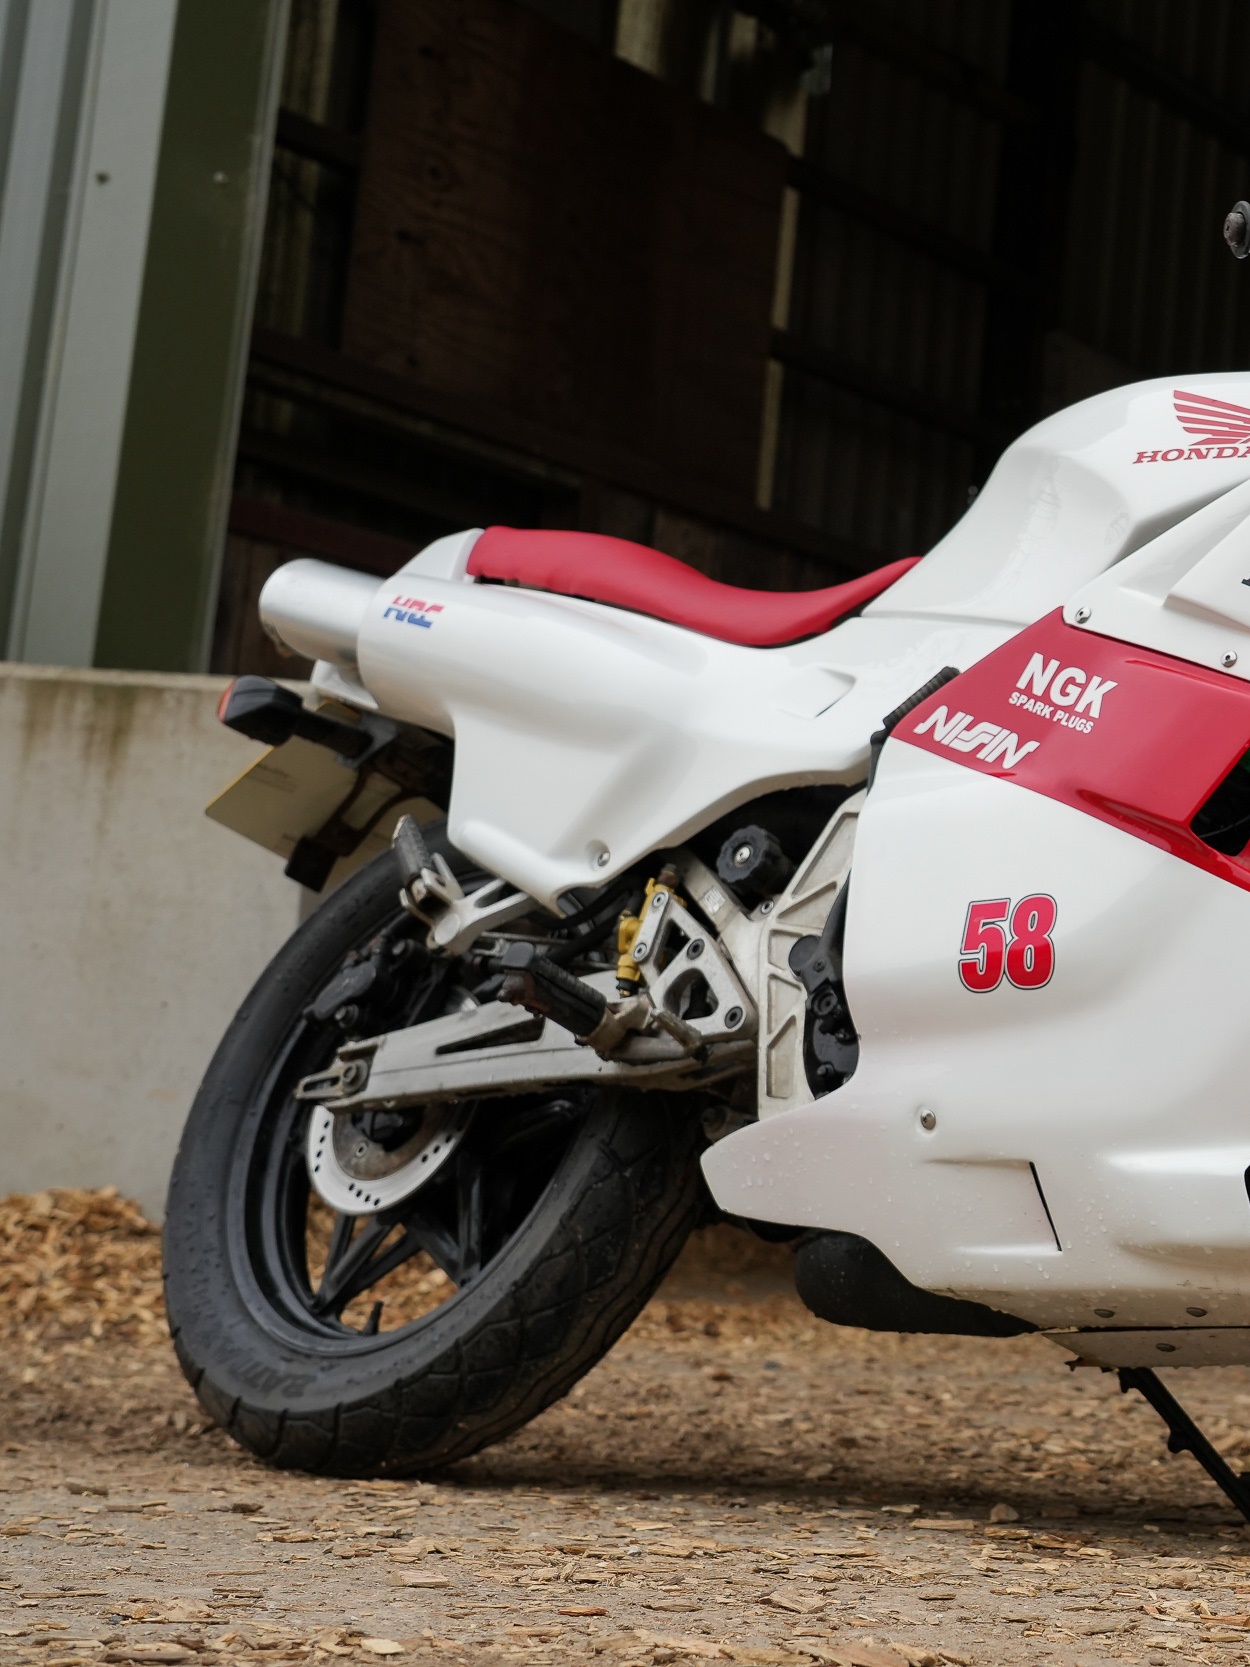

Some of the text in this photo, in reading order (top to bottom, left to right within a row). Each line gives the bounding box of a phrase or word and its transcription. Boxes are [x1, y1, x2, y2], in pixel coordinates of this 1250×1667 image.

[383, 594, 445, 629] HRC
[1008, 691, 1094, 735] SPARK PLUGS
[1015, 651, 1119, 719] NGK
[957, 892, 1058, 994] 58
